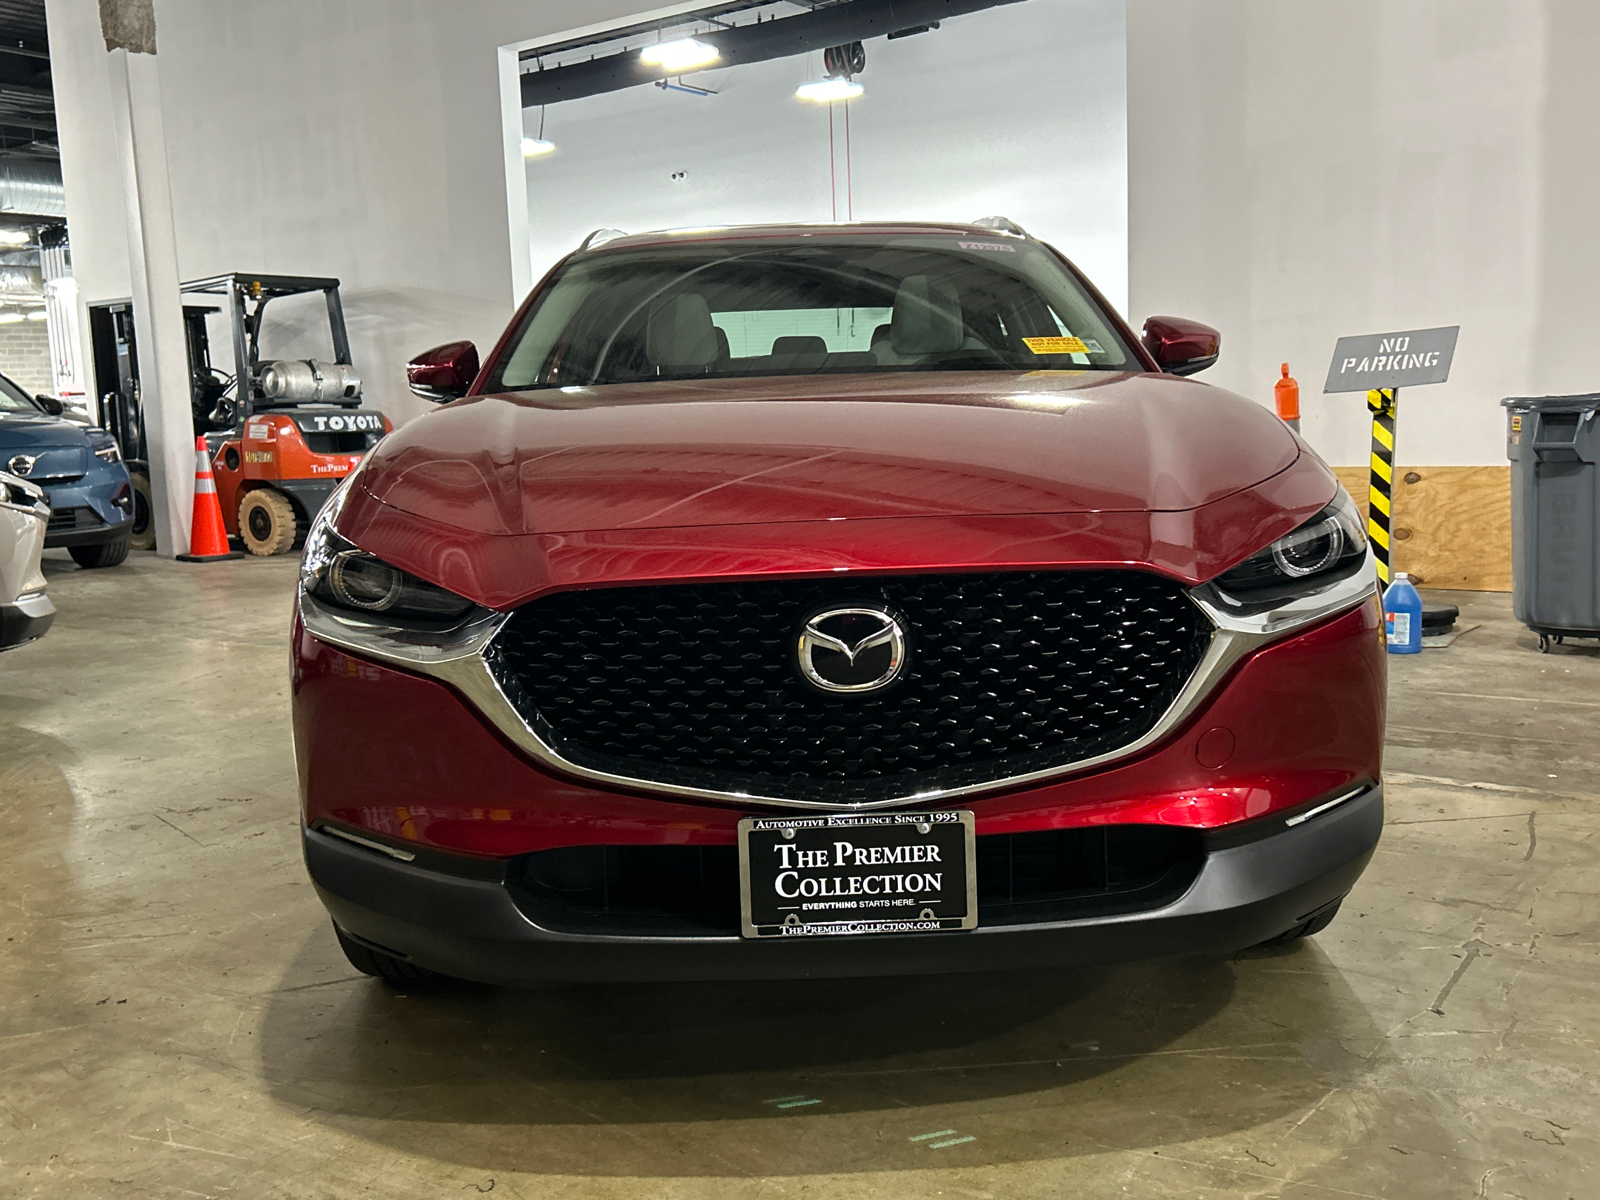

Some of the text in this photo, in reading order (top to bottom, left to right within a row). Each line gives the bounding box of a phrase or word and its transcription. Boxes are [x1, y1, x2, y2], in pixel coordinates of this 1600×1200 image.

[1379, 337, 1410, 353] NO
[1340, 351, 1440, 374] PARKING
[313, 415, 382, 431] TOYOTA
[755, 812, 958, 829] AUTOMOTIVE EXCELLENCE SINCE 1995
[774, 841, 942, 869] THE PREMIER
[775, 871, 943, 898] COLLECTION
[802, 901, 858, 910] EVERYTHING
[859, 899, 890, 908] STARTS
[779, 921, 941, 936] THEPREMIERCOLLECTION.COM
